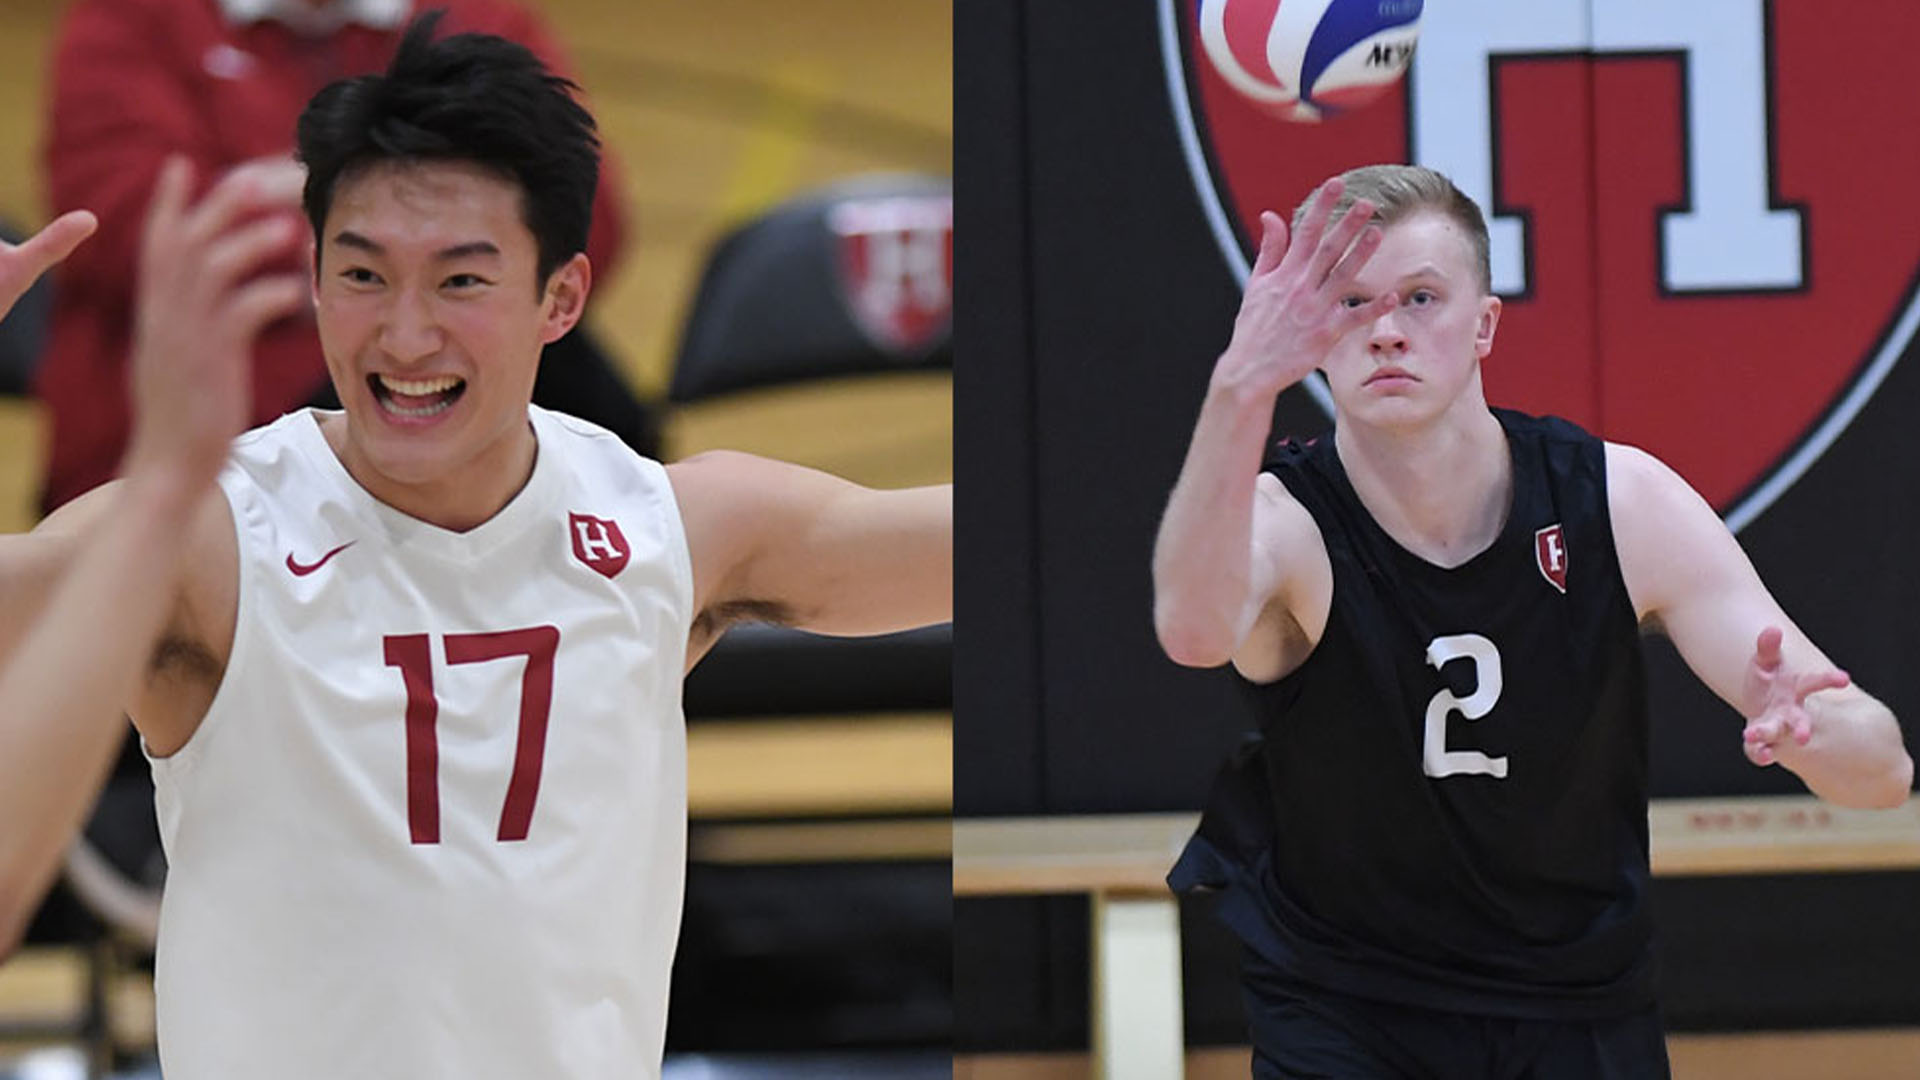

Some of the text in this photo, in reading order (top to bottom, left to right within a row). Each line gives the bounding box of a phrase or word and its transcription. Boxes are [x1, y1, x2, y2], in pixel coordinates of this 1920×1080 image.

[575, 521, 623, 560] H
[383, 624, 560, 844] 17
[1424, 633, 1508, 778] 2
